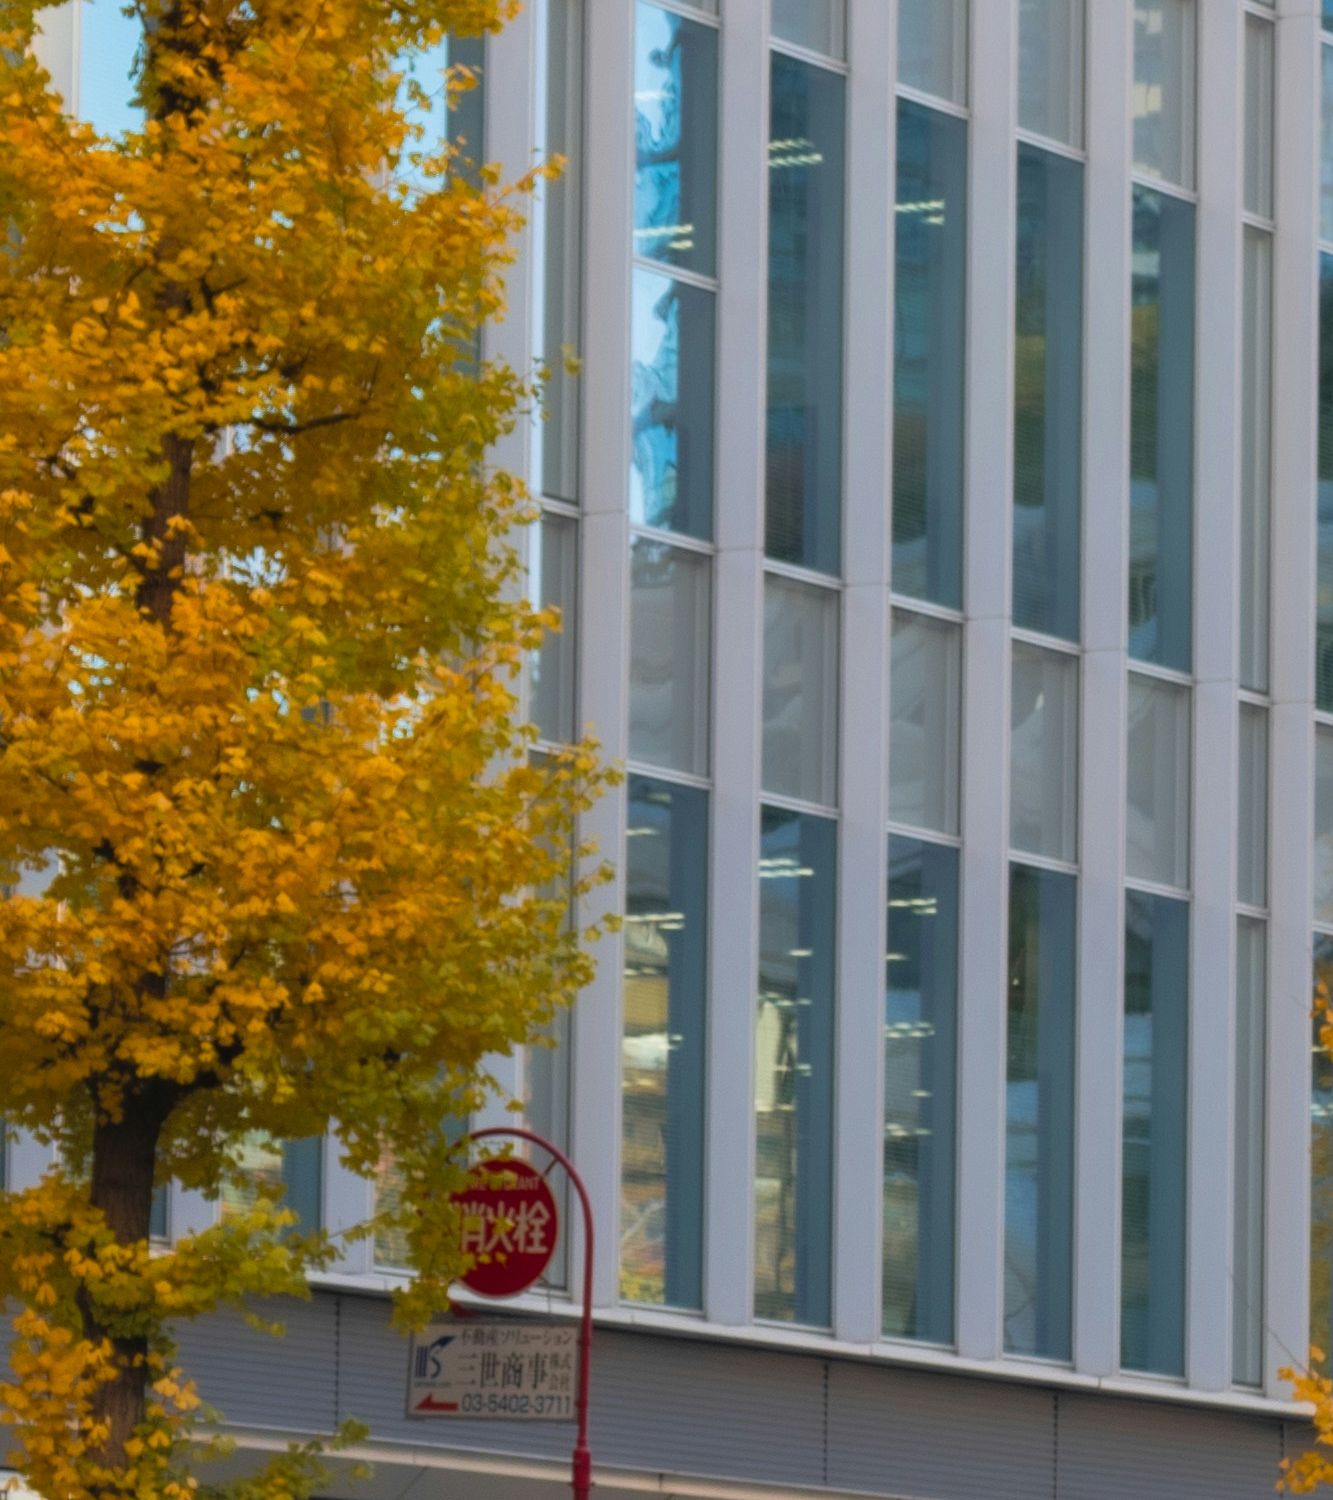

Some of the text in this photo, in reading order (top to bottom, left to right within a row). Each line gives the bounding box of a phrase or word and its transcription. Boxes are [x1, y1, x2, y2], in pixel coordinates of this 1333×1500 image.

[461, 1328, 573, 1345] 不動産ソリューション
[461, 1394, 571, 1414] 03-5402-3711
